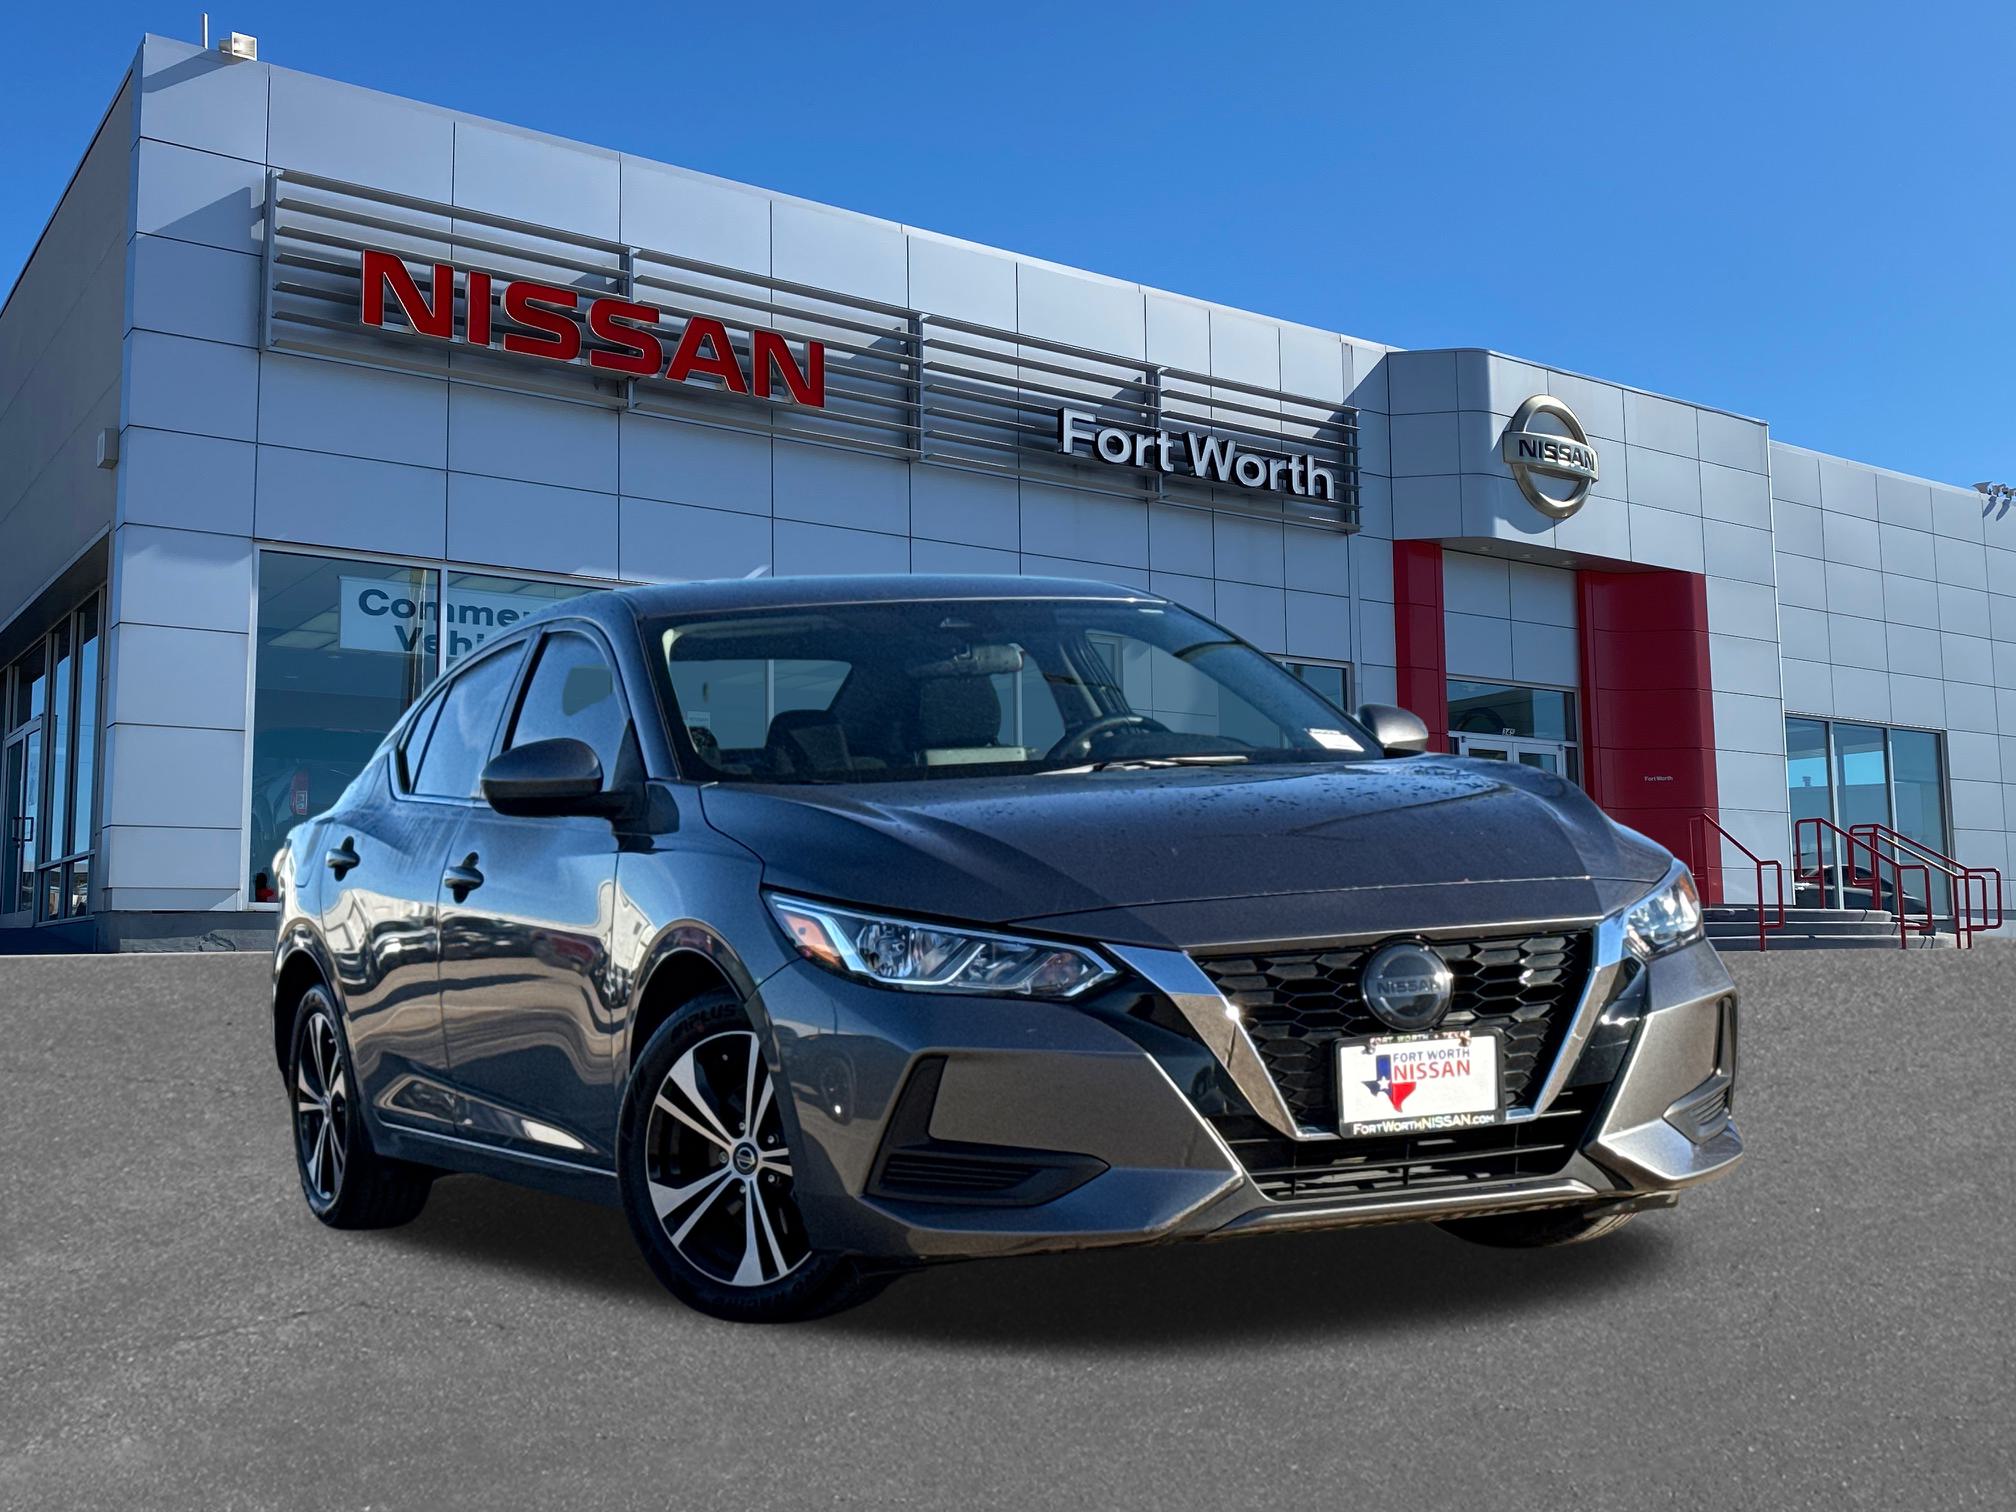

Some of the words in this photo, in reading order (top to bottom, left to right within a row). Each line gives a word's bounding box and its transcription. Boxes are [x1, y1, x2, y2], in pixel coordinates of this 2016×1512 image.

[360, 248, 826, 408] NISSAN
[1058, 407, 1175, 472] Fort
[1182, 430, 1336, 501] Worth
[1518, 439, 1595, 472] NISSAN
[1376, 978, 1441, 995] NISSAN
[1369, 1035, 1394, 1045] FORT
[1397, 1033, 1429, 1043] WORTH
[1393, 1051, 1423, 1063] FORT
[1427, 1048, 1470, 1061] WORTH
[1393, 1060, 1470, 1081] NISSAN
